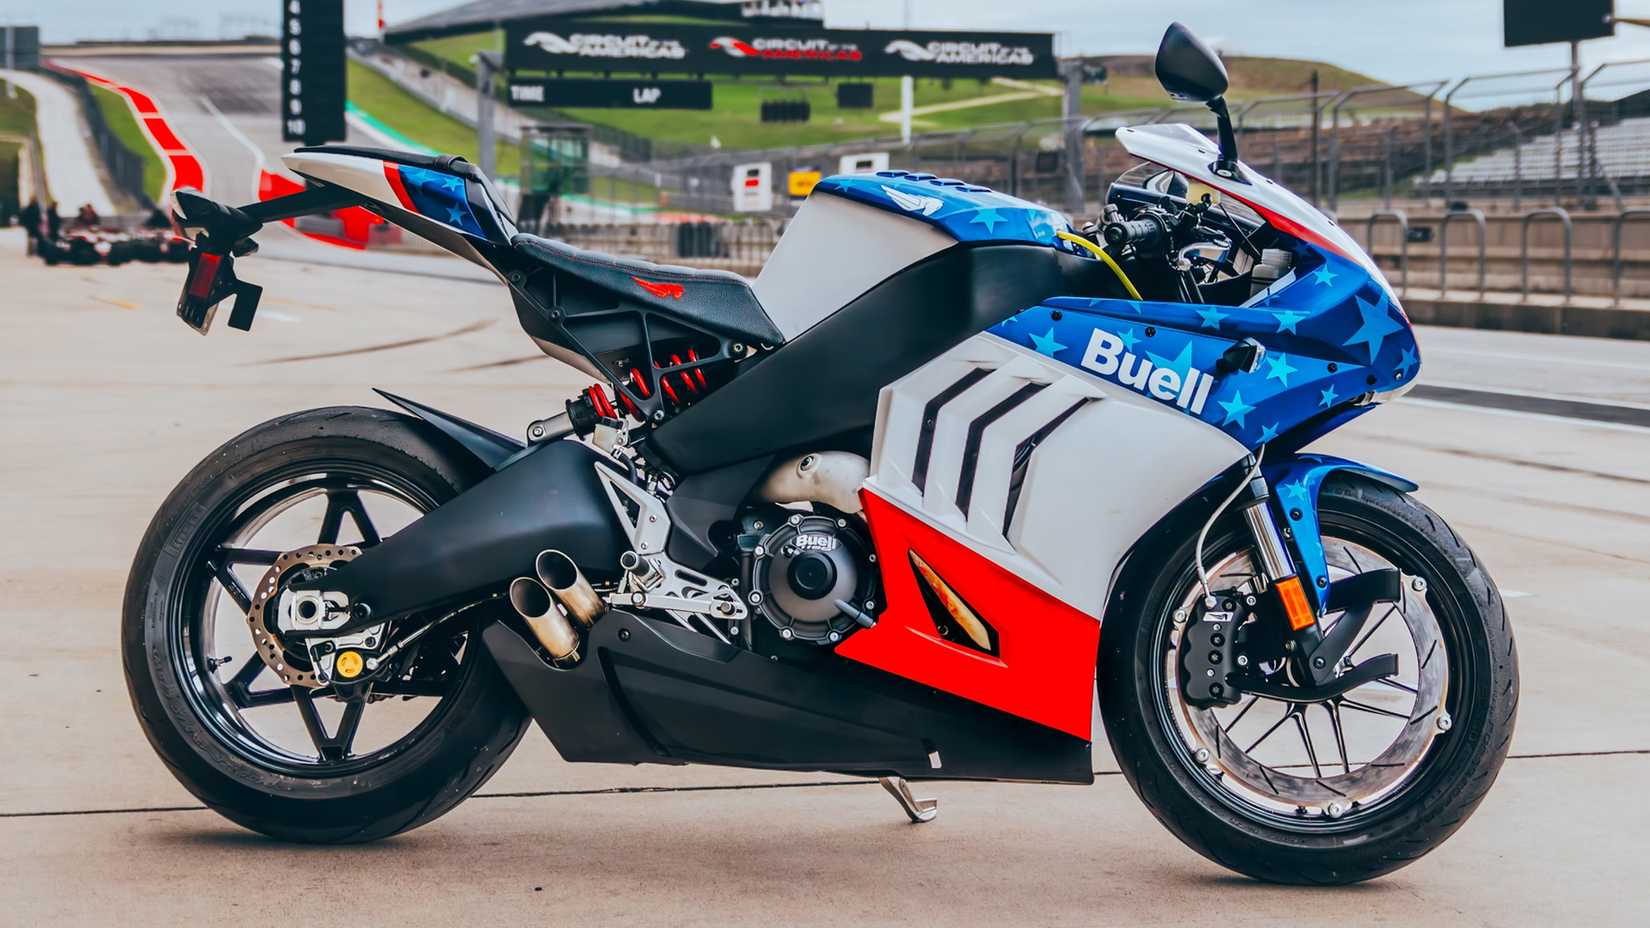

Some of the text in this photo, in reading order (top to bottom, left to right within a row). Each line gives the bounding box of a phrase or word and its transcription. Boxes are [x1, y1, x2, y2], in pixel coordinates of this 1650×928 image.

[752, 37, 829, 50] CIRCUIT
[632, 88, 661, 103] LAP
[1080, 327, 1214, 415] Buell
[795, 534, 837, 550] Buell
